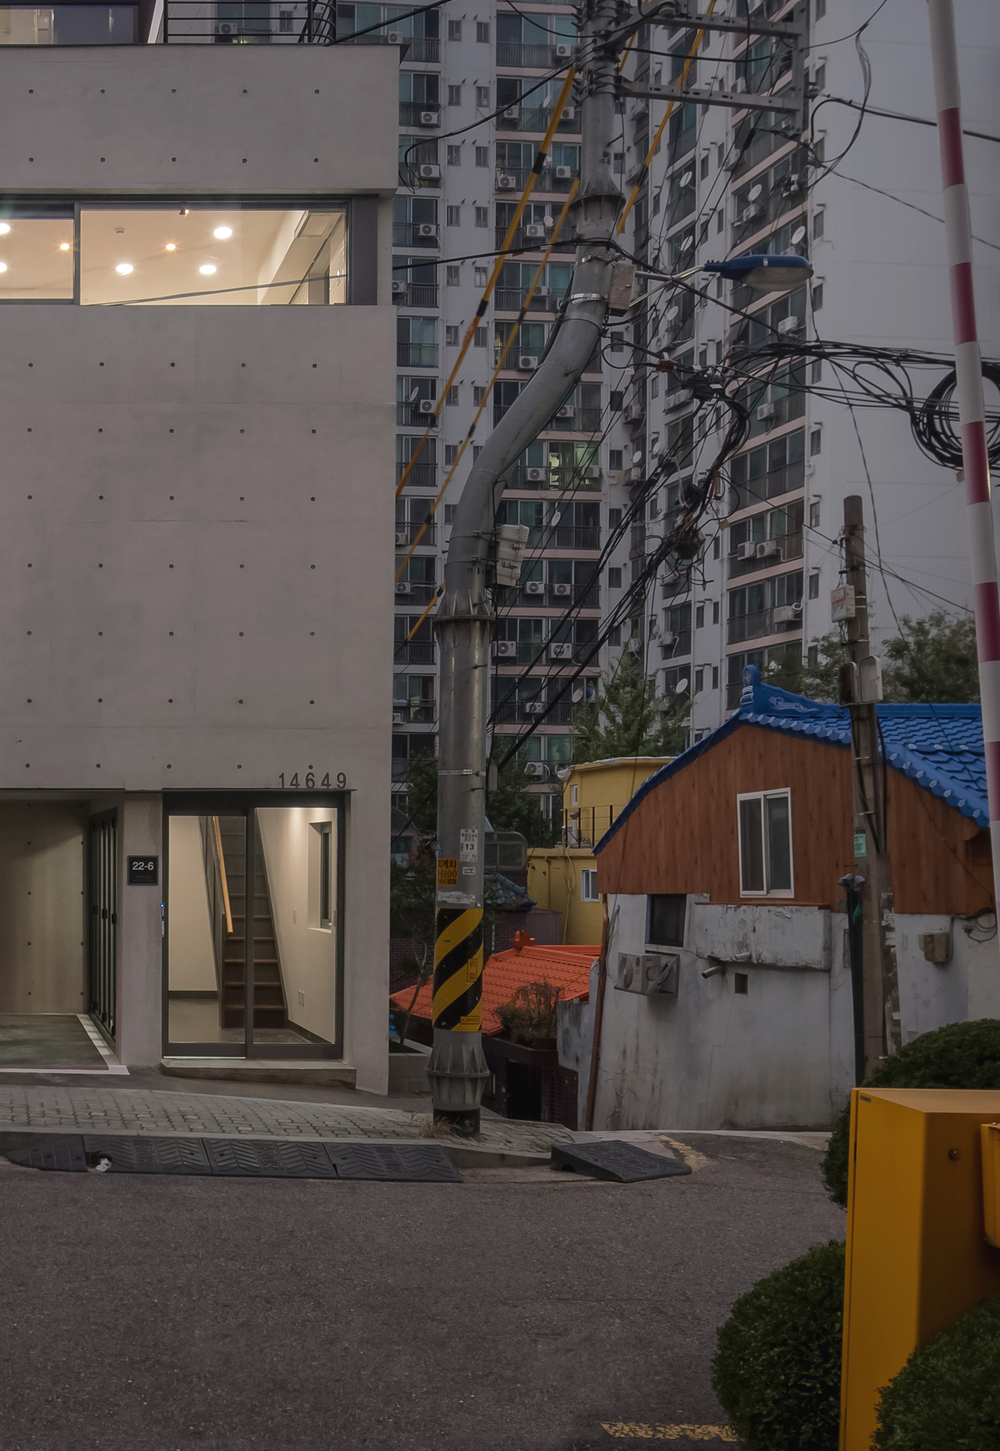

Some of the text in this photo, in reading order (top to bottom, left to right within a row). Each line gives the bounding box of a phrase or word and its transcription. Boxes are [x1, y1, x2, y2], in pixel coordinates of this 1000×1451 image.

[279, 772, 347, 789] 14649
[465, 843, 475, 851] 13
[132, 861, 154, 871] 22-6
